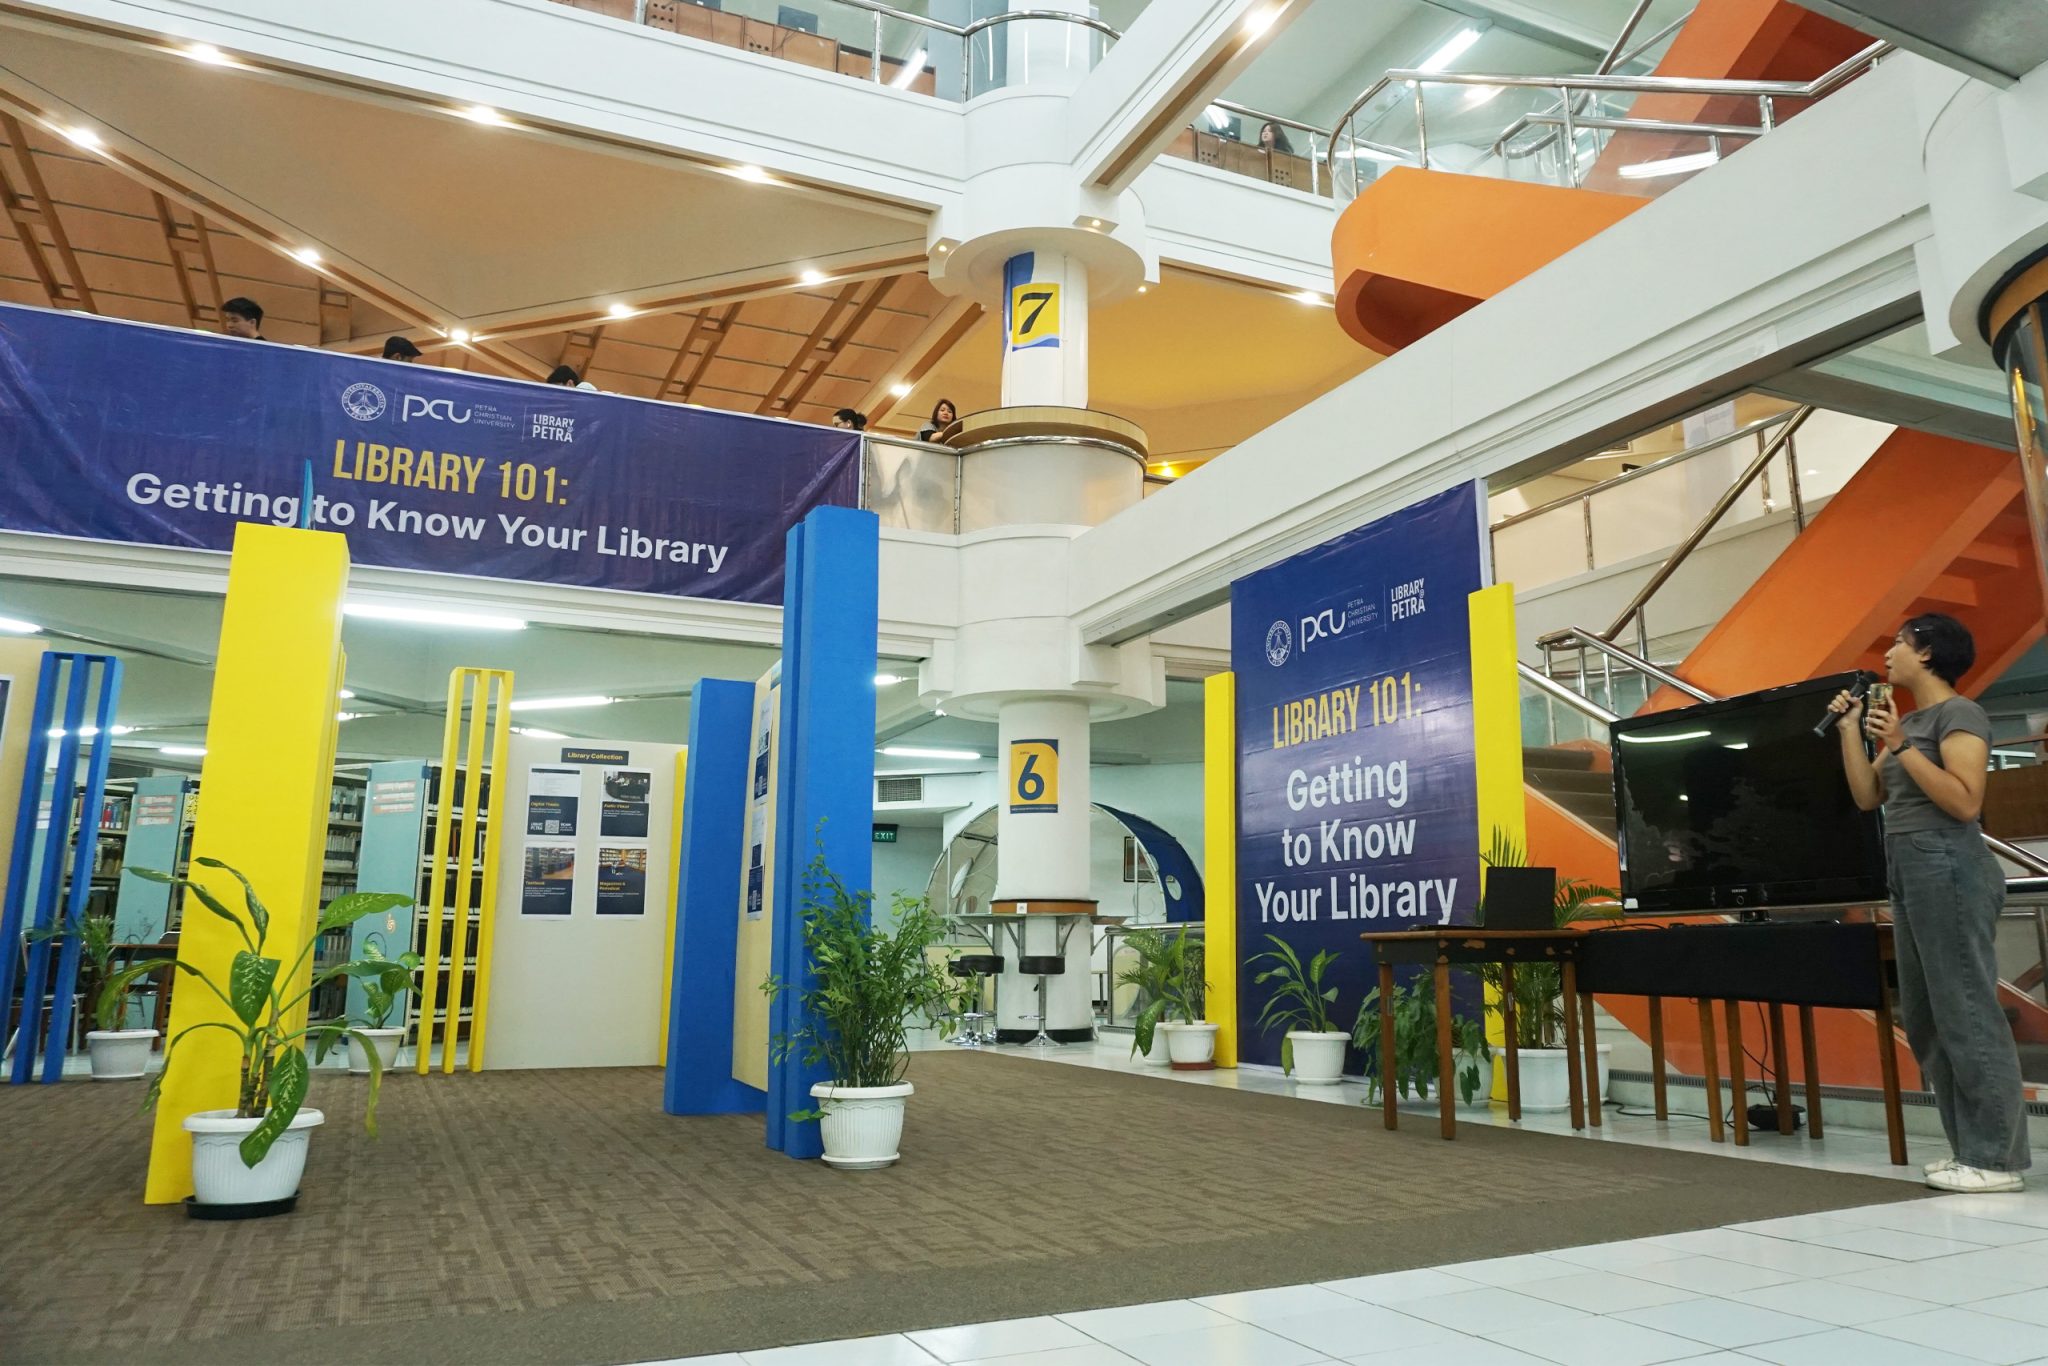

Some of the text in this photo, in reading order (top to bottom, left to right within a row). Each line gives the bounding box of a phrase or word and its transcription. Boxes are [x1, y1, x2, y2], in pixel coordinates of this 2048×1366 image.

[1018, 292, 1053, 335] 7
[474, 411, 512, 422] CHRISTIAN
[475, 404, 497, 412] PETRA
[473, 419, 516, 429] UNIVERSITY
[532, 413, 575, 428] LIBRARY
[532, 425, 573, 442] PETRA
[333, 439, 570, 505] LIBRARY 101:
[126, 472, 729, 573] Getting to Know Your Library
[1391, 578, 1425, 602] LIBRARY
[1347, 598, 1364, 609] PETRA
[1347, 603, 1376, 618] CHRISTIAN
[1392, 596, 1426, 622] PETRA
[1347, 612, 1378, 628] UNIVERSITY
[1273, 672, 1422, 749] LIBRARY 101:
[567, 752, 624, 761] Library Collection
[1018, 754, 1044, 800] 6
[1286, 755, 1408, 811] Getting
[874, 832, 895, 840] EXIT
[1282, 819, 1417, 867] to Know
[1255, 873, 1458, 925] Your Library
